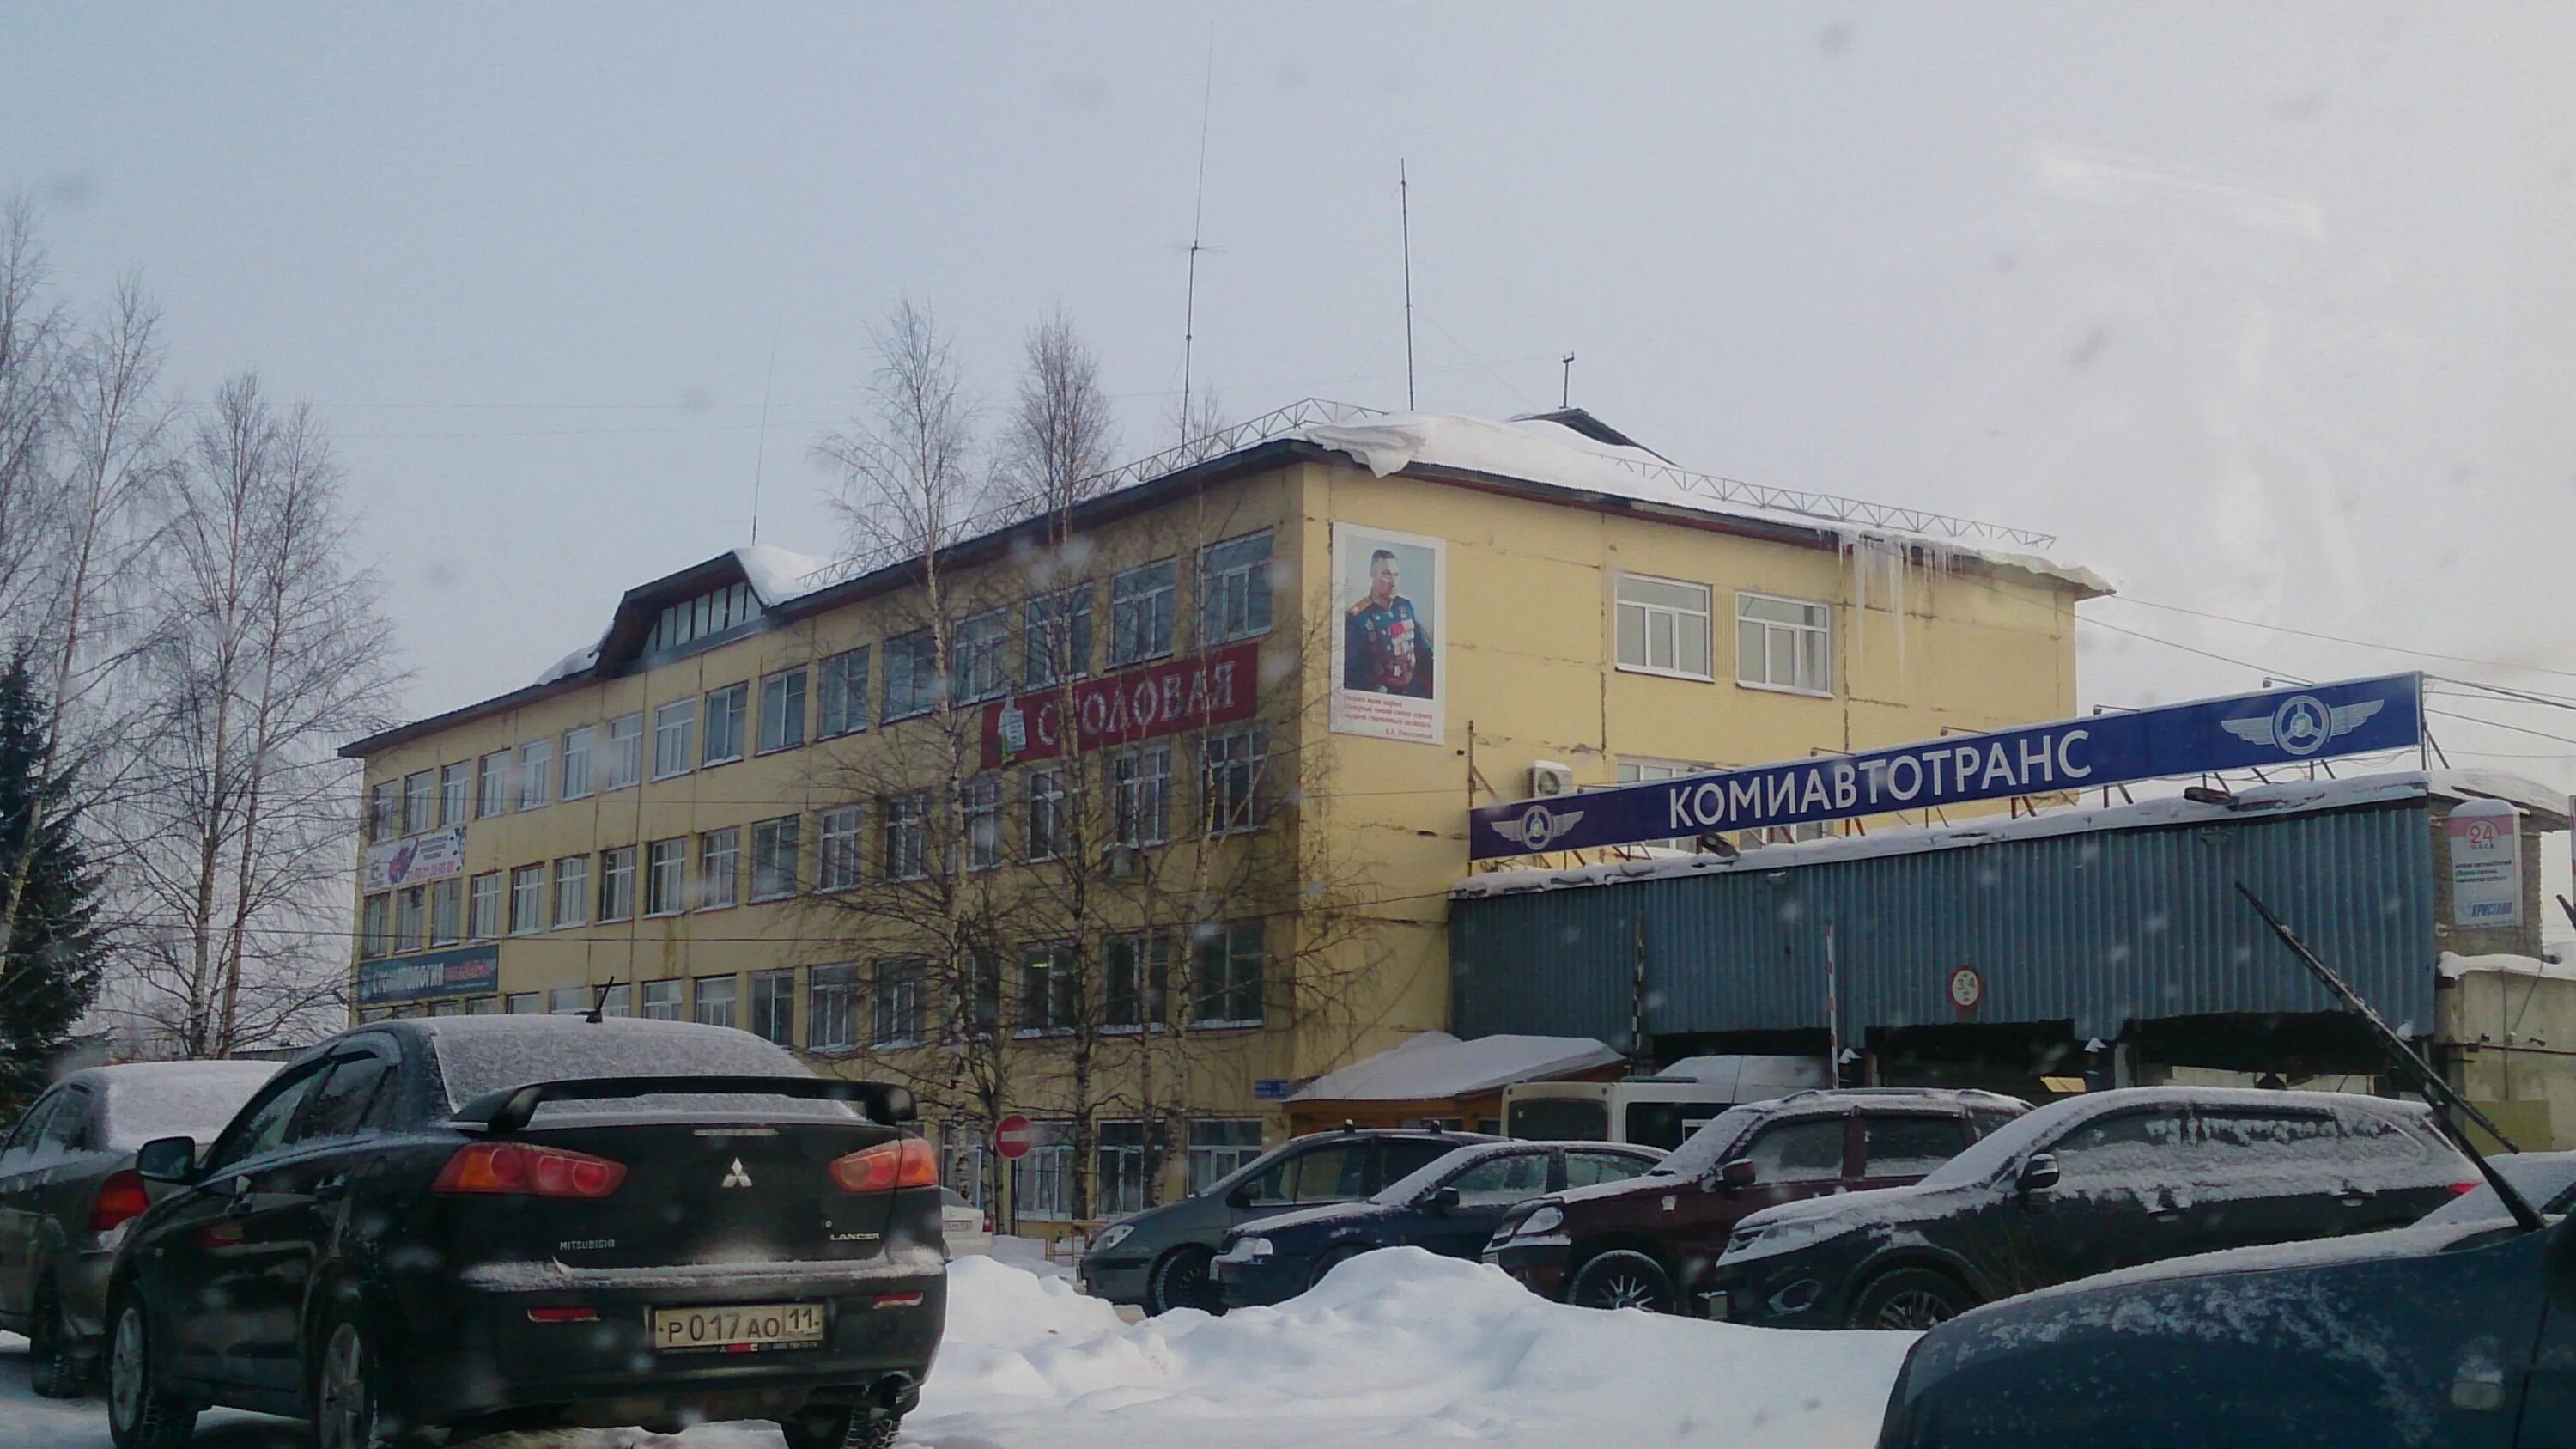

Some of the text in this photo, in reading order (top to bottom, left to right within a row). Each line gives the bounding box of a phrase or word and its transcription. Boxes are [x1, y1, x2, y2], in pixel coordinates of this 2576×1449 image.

[1037, 661, 1235, 746] СОЛОВАЯ
[1669, 729, 2092, 830] КОМИАВТОТРАНС
[2469, 825, 2494, 844] 24
[559, 1239, 616, 1251] MITSUBISHI
[829, 1233, 880, 1241] LANCER
